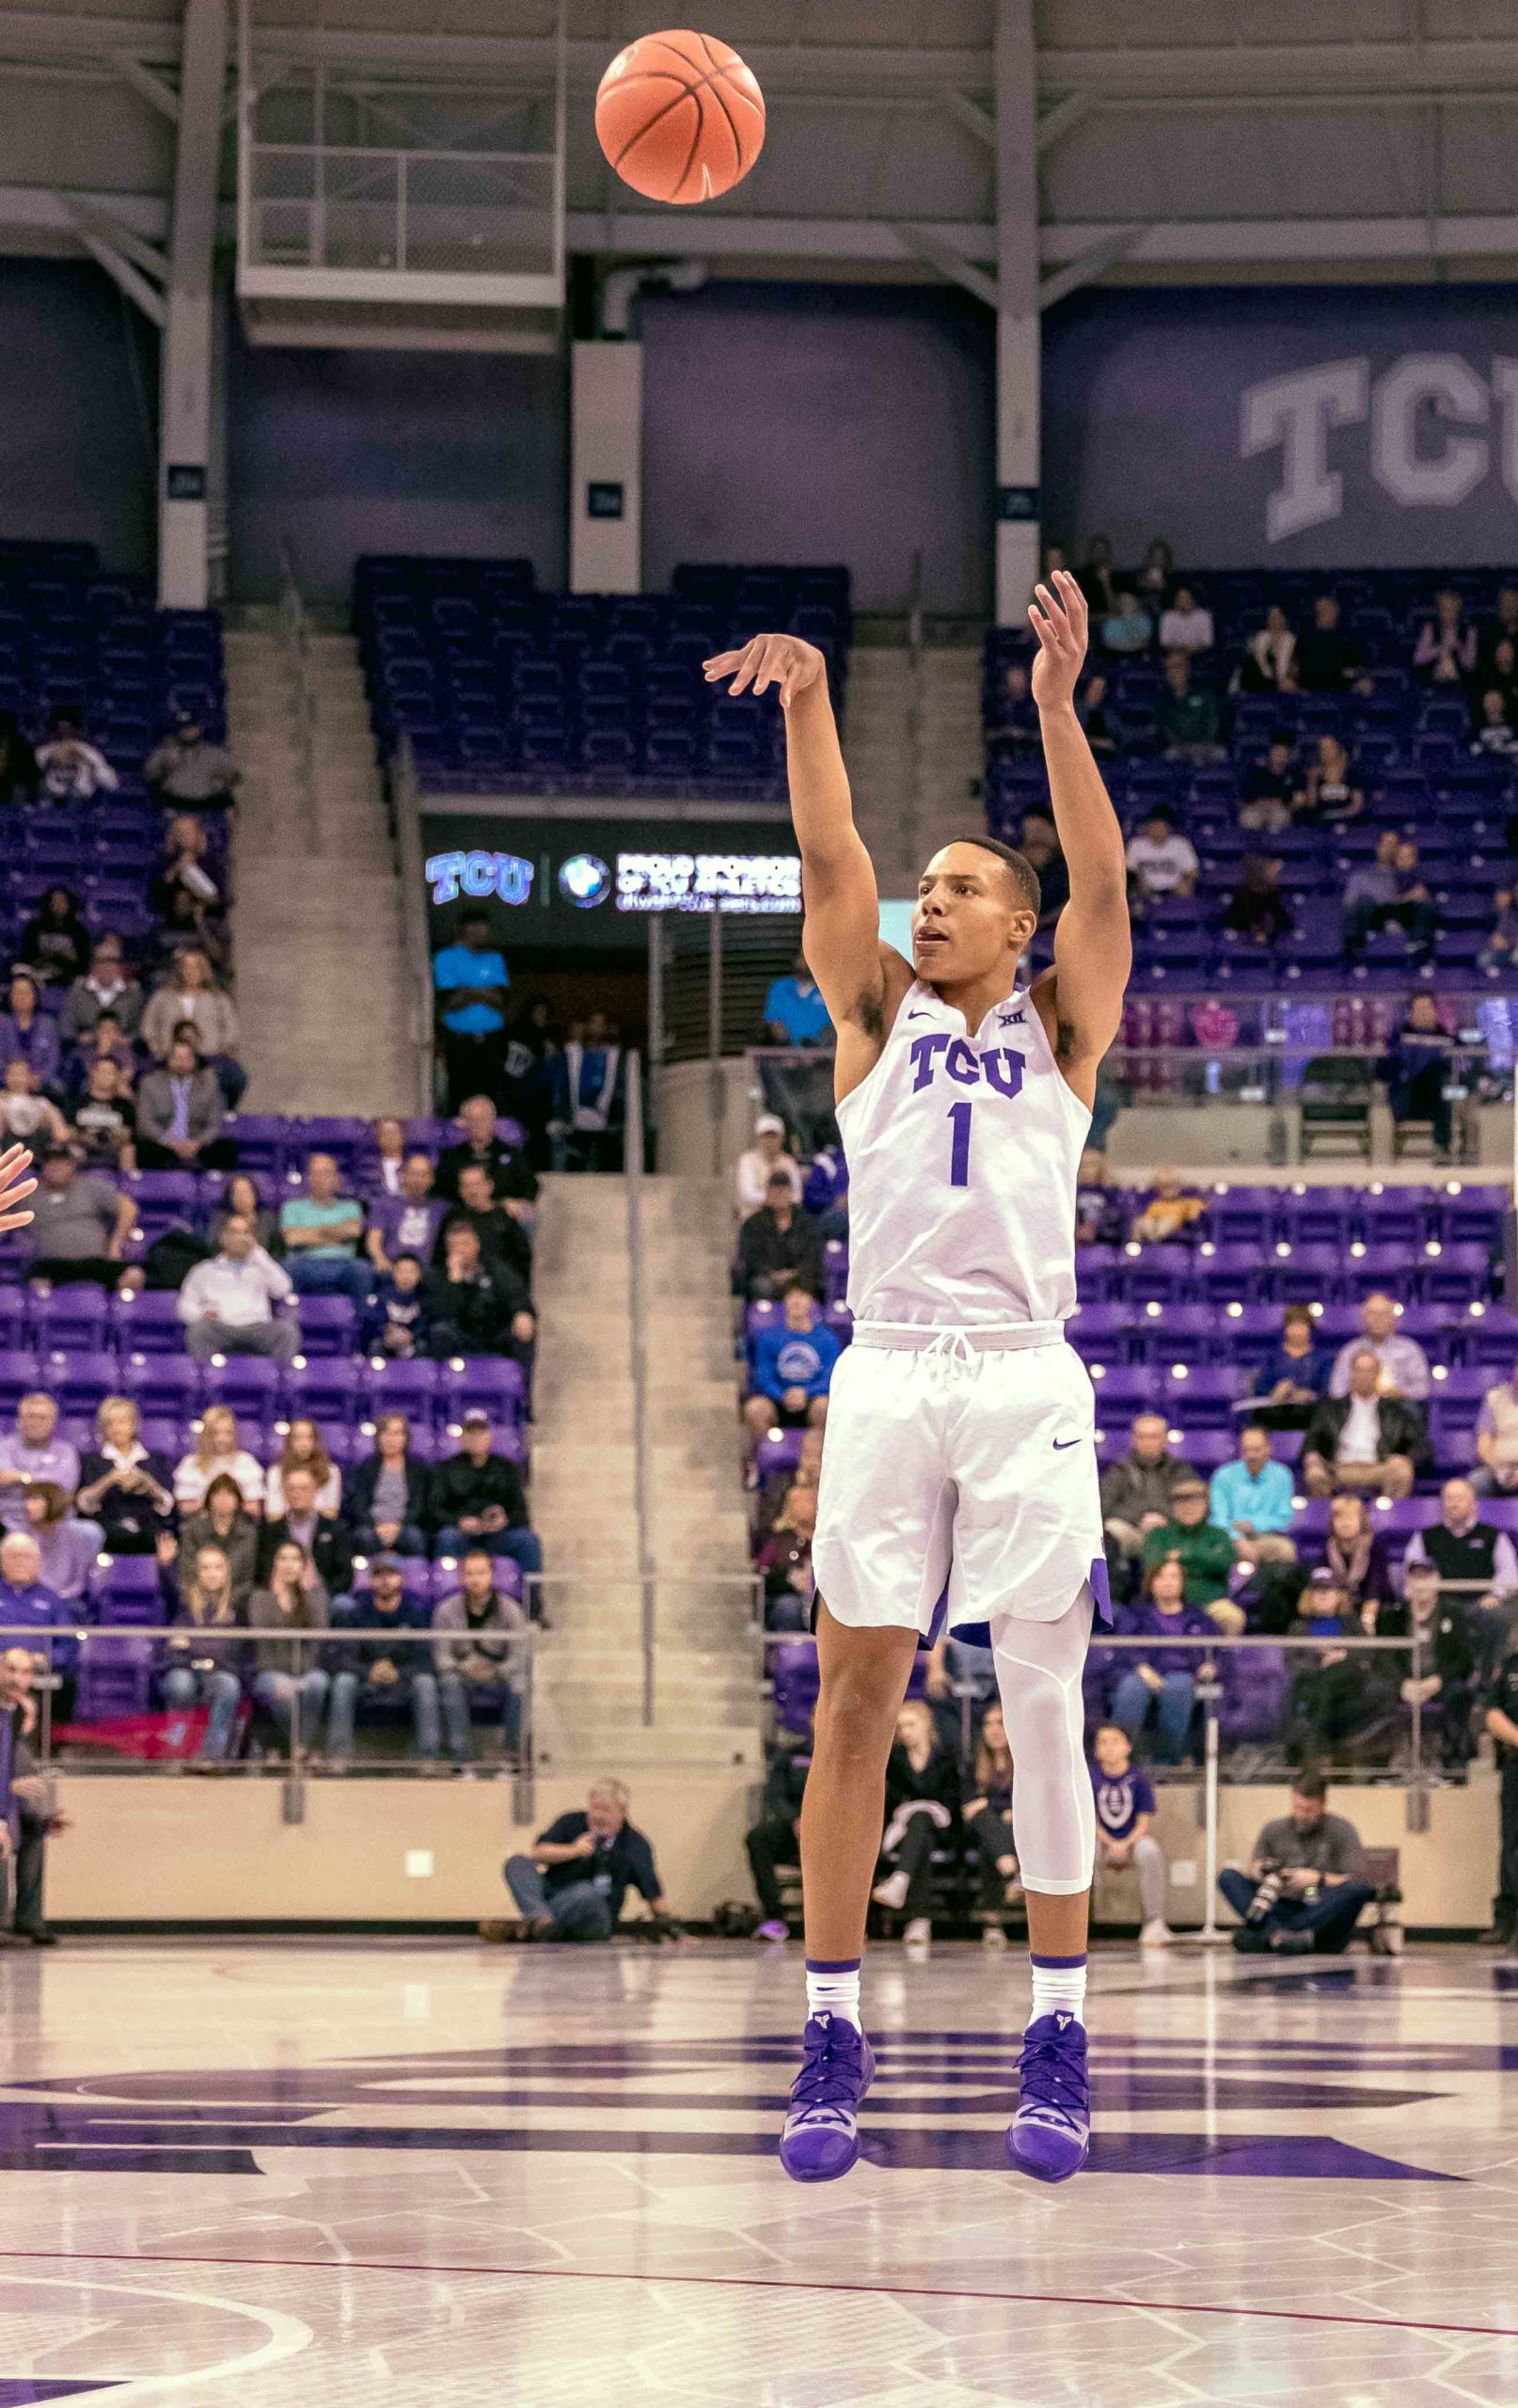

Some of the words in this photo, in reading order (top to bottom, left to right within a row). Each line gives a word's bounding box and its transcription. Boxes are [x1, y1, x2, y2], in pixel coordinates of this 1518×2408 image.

[1237, 352, 1518, 545] TC
[425, 849, 534, 905] TCU
[997, 1009, 1026, 1027] XII
[909, 1034, 1026, 1100] TCU
[947, 1102, 972, 1186] 1
